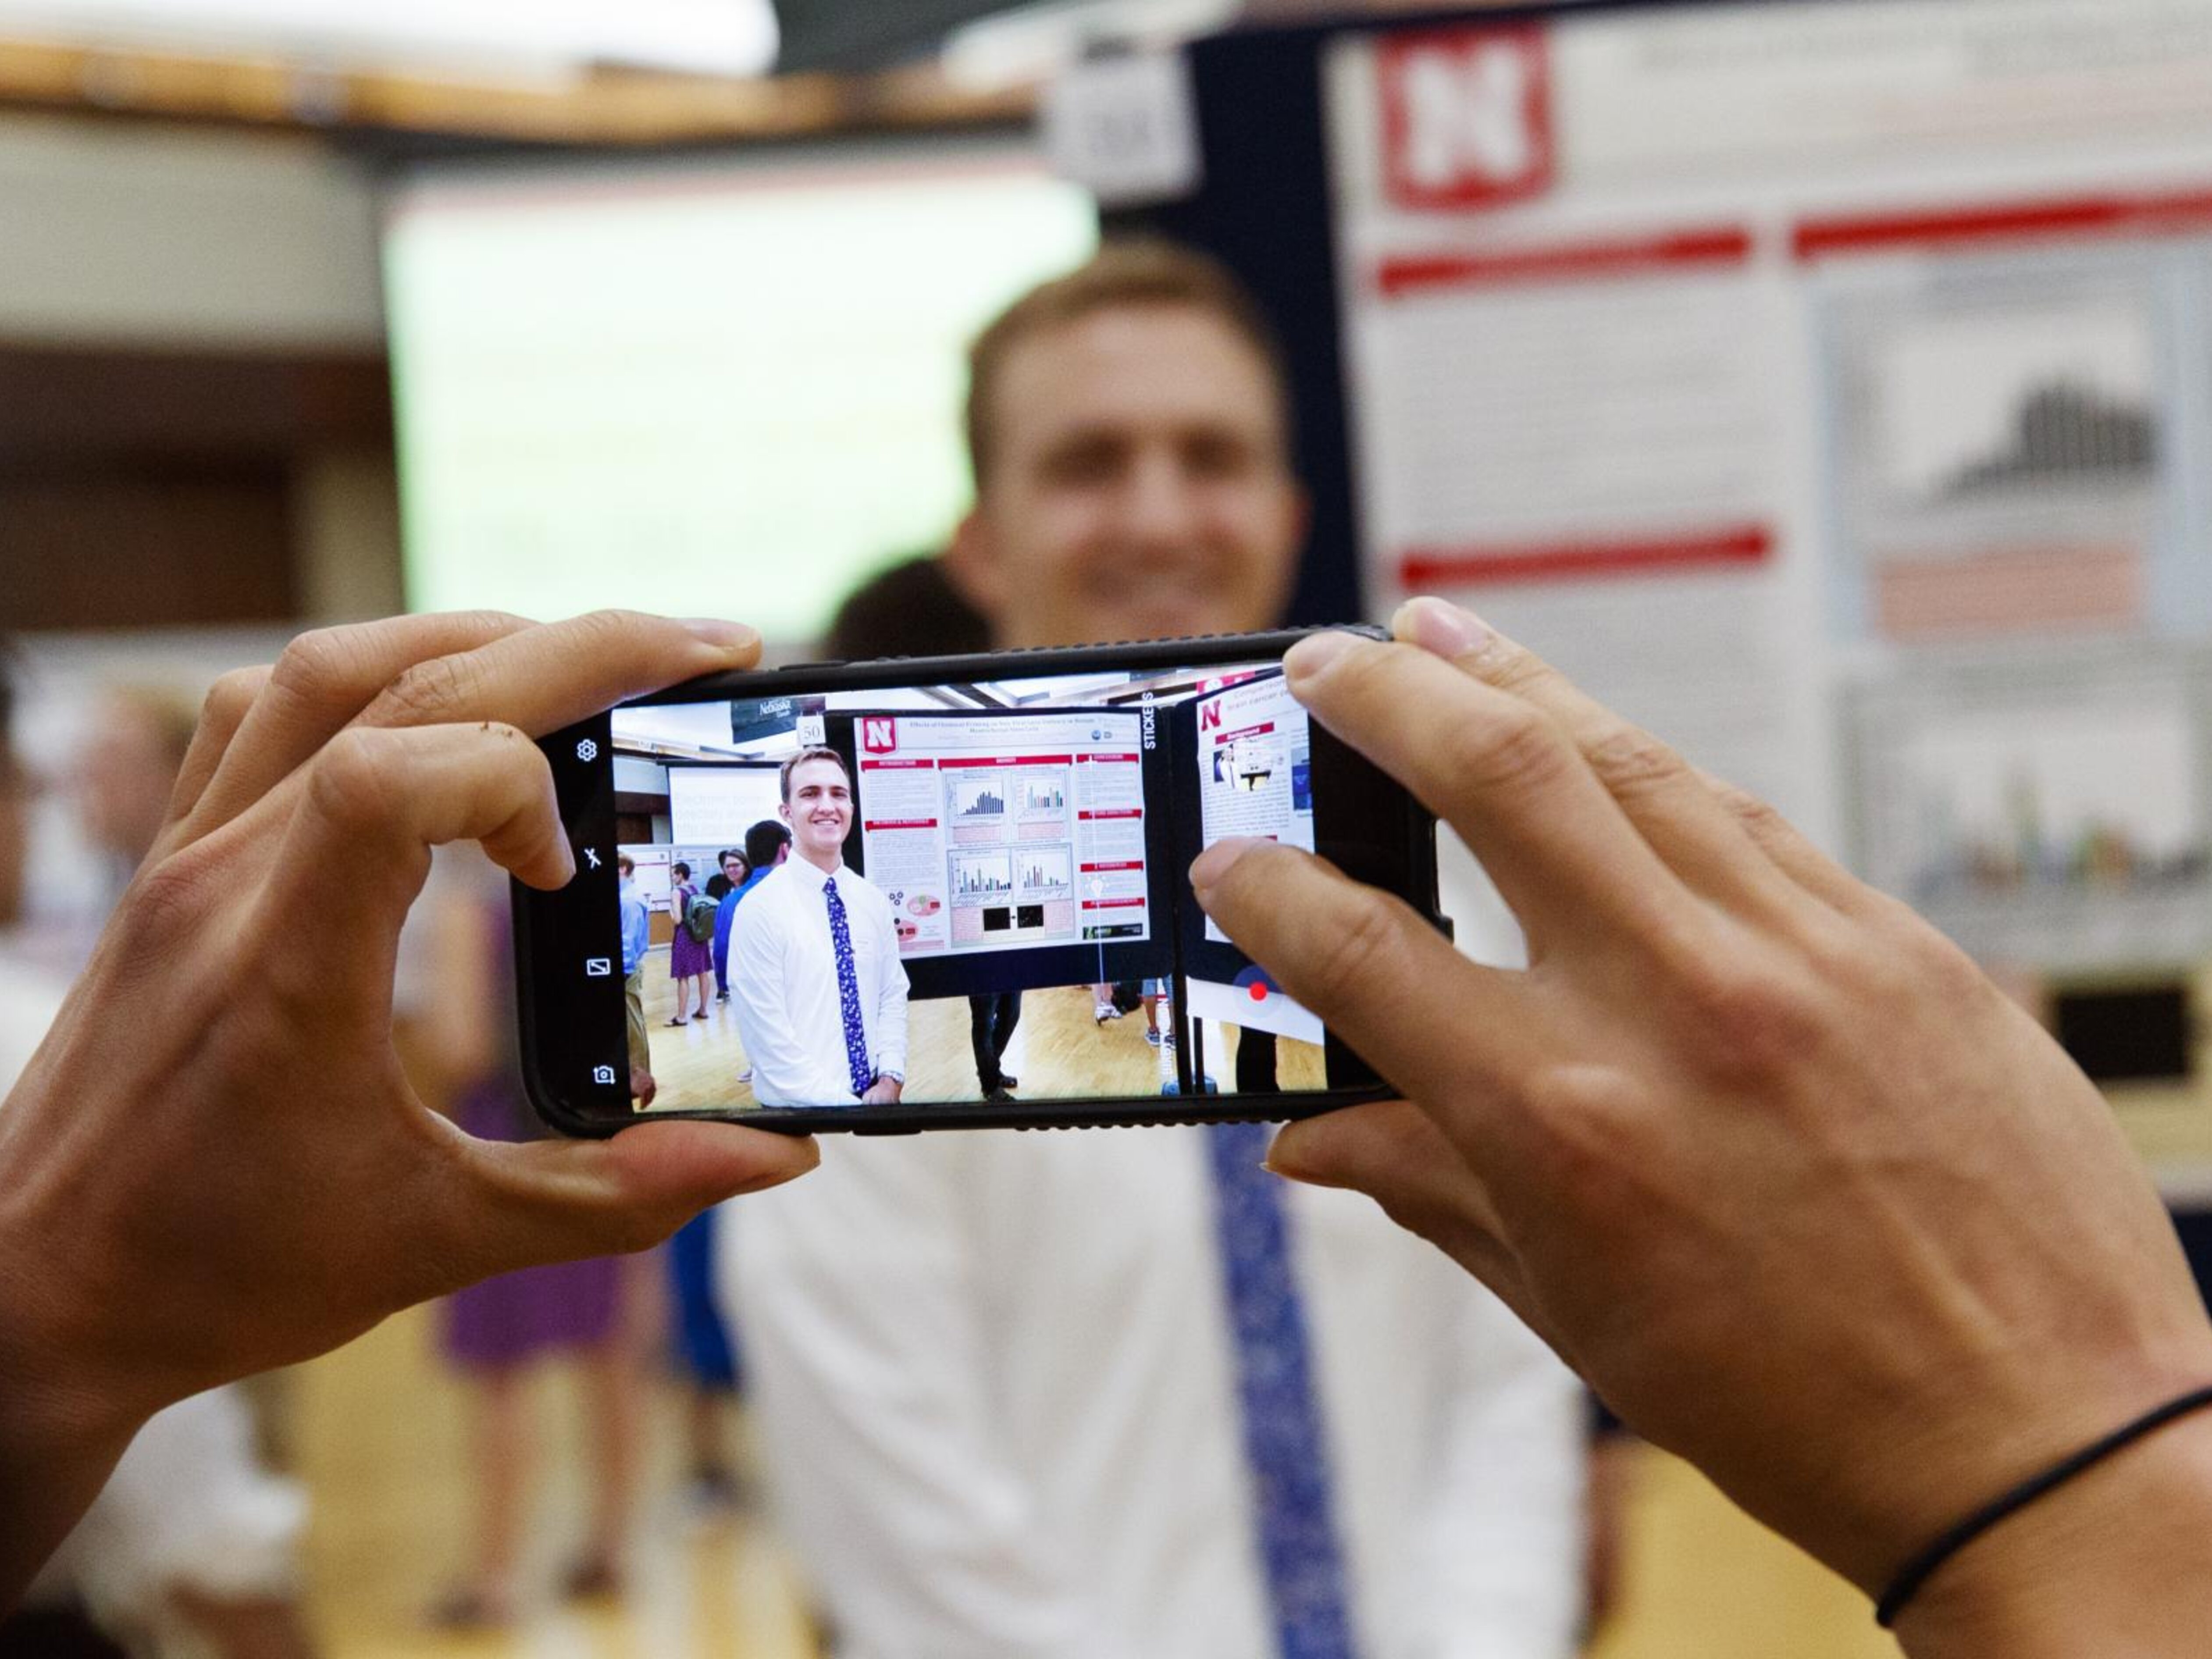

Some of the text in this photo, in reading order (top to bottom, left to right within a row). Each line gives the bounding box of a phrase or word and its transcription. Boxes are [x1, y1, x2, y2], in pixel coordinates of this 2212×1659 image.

[1407, 47, 1528, 181] N
[1201, 700, 1221, 731] N
[804, 725, 820, 739] 50
[867, 721, 893, 747] N
